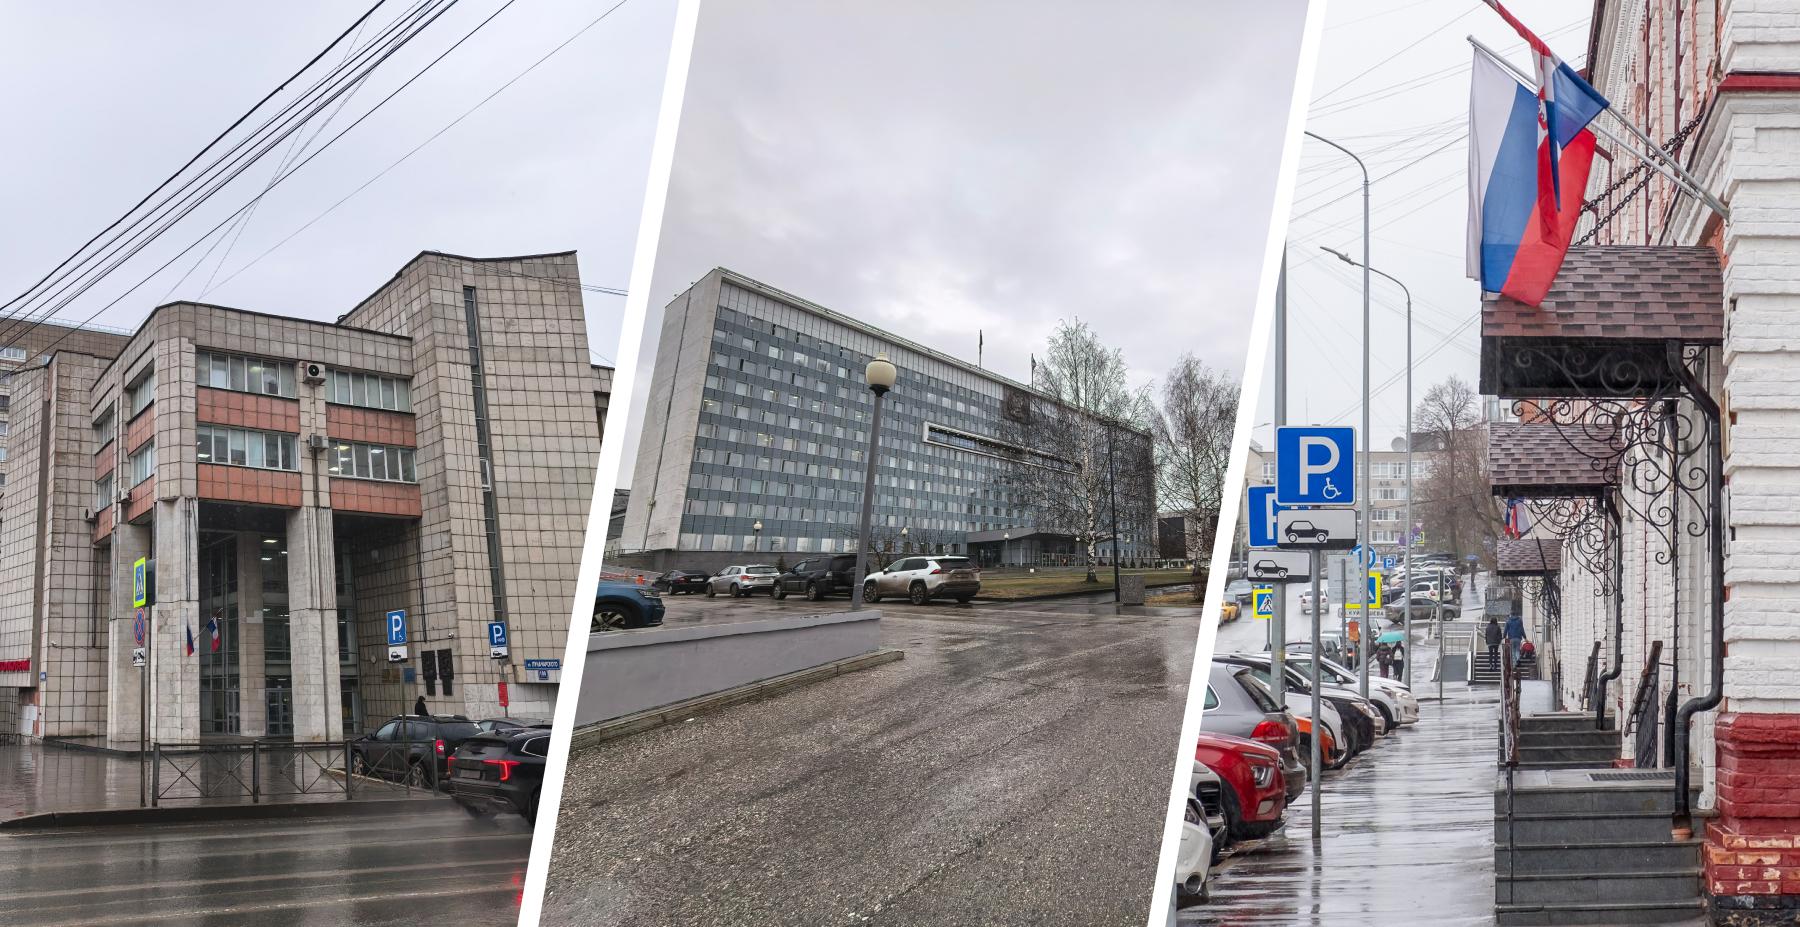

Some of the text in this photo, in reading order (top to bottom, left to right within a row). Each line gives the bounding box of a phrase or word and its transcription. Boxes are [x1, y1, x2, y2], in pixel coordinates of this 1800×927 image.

[1299, 435, 1340, 496] P
[1386, 558, 1393, 568] P
[392, 615, 403, 641] P
[493, 625, 503, 644] P
